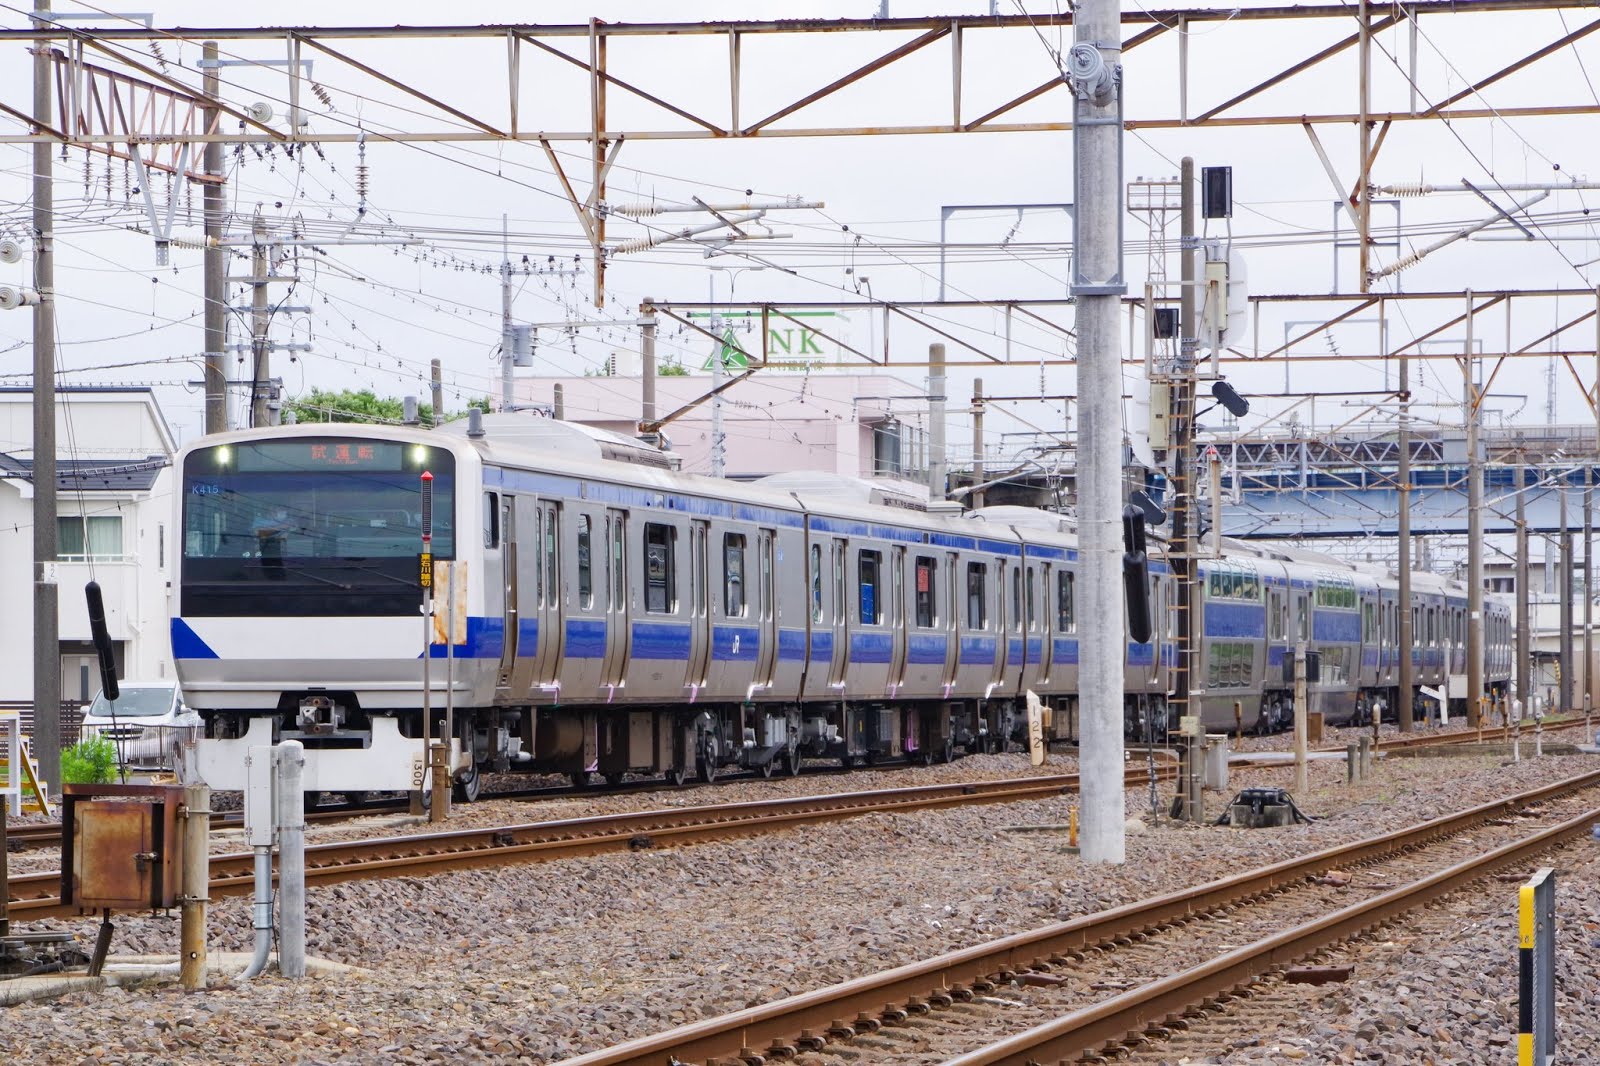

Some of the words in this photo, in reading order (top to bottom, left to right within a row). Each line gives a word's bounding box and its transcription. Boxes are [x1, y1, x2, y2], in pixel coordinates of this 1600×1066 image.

[768, 328, 824, 355] NK
[192, 485, 219, 494] K415
[732, 634, 740, 654] JR
[412, 759, 423, 786] 1300
